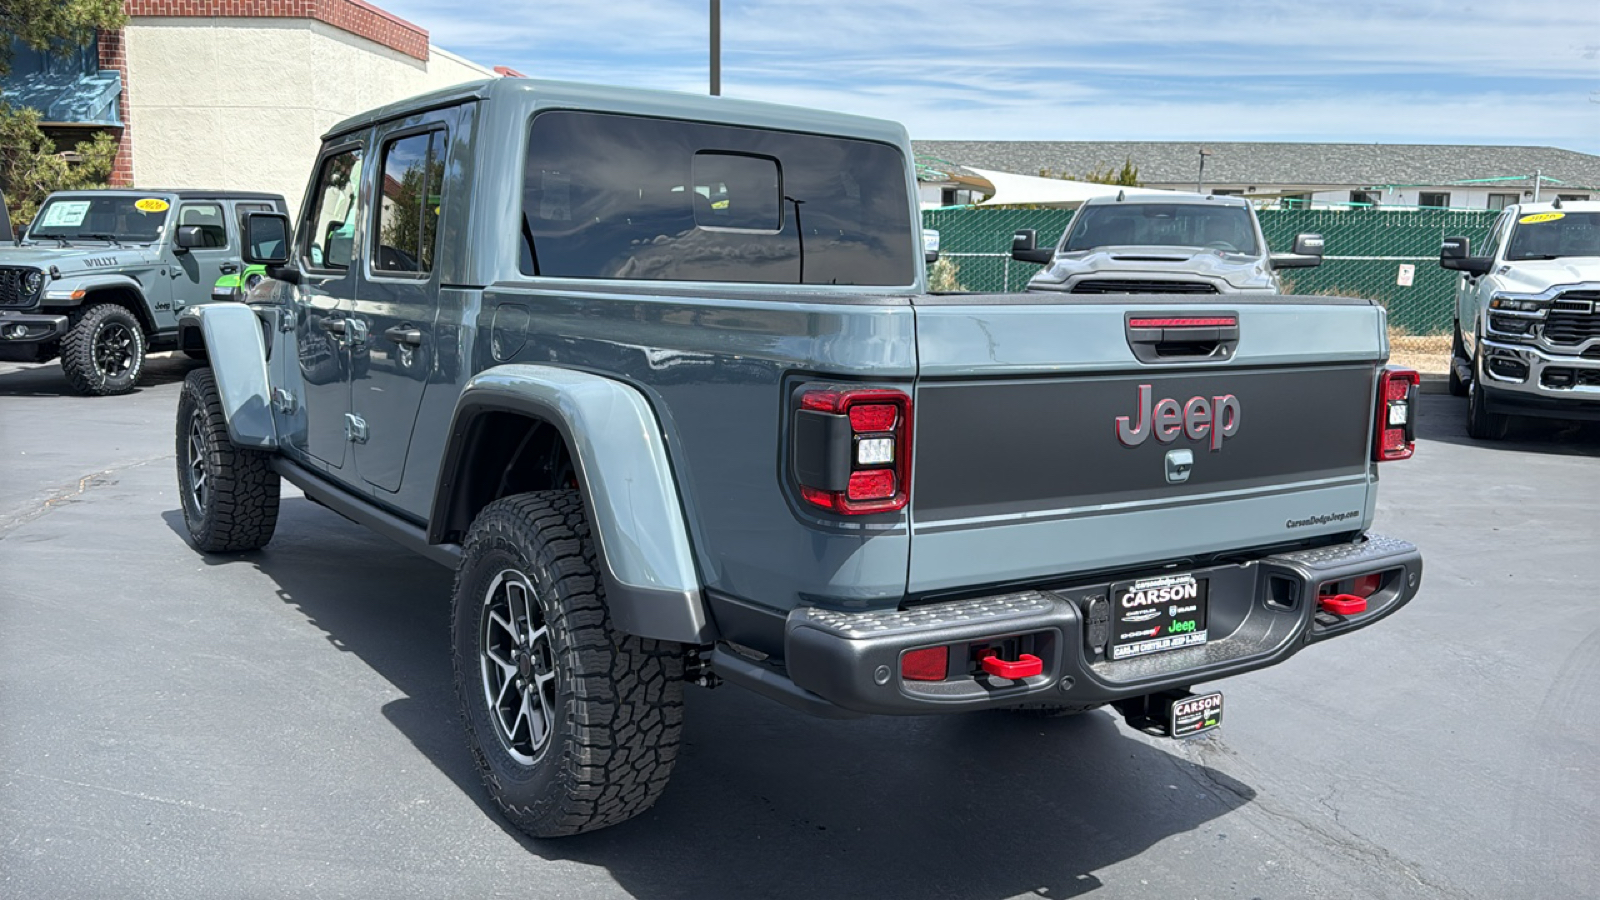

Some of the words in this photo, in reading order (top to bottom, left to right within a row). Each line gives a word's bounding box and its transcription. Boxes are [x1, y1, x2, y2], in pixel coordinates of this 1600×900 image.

[154, 302, 171, 310] Jeep
[1115, 384, 1241, 451] Jeep
[1286, 510, 1359, 529] CarsonDodgeJeep.com
[1122, 583, 1197, 608] CARSON
[1168, 619, 1196, 633] Jeep
[1176, 697, 1220, 715] CARSON
